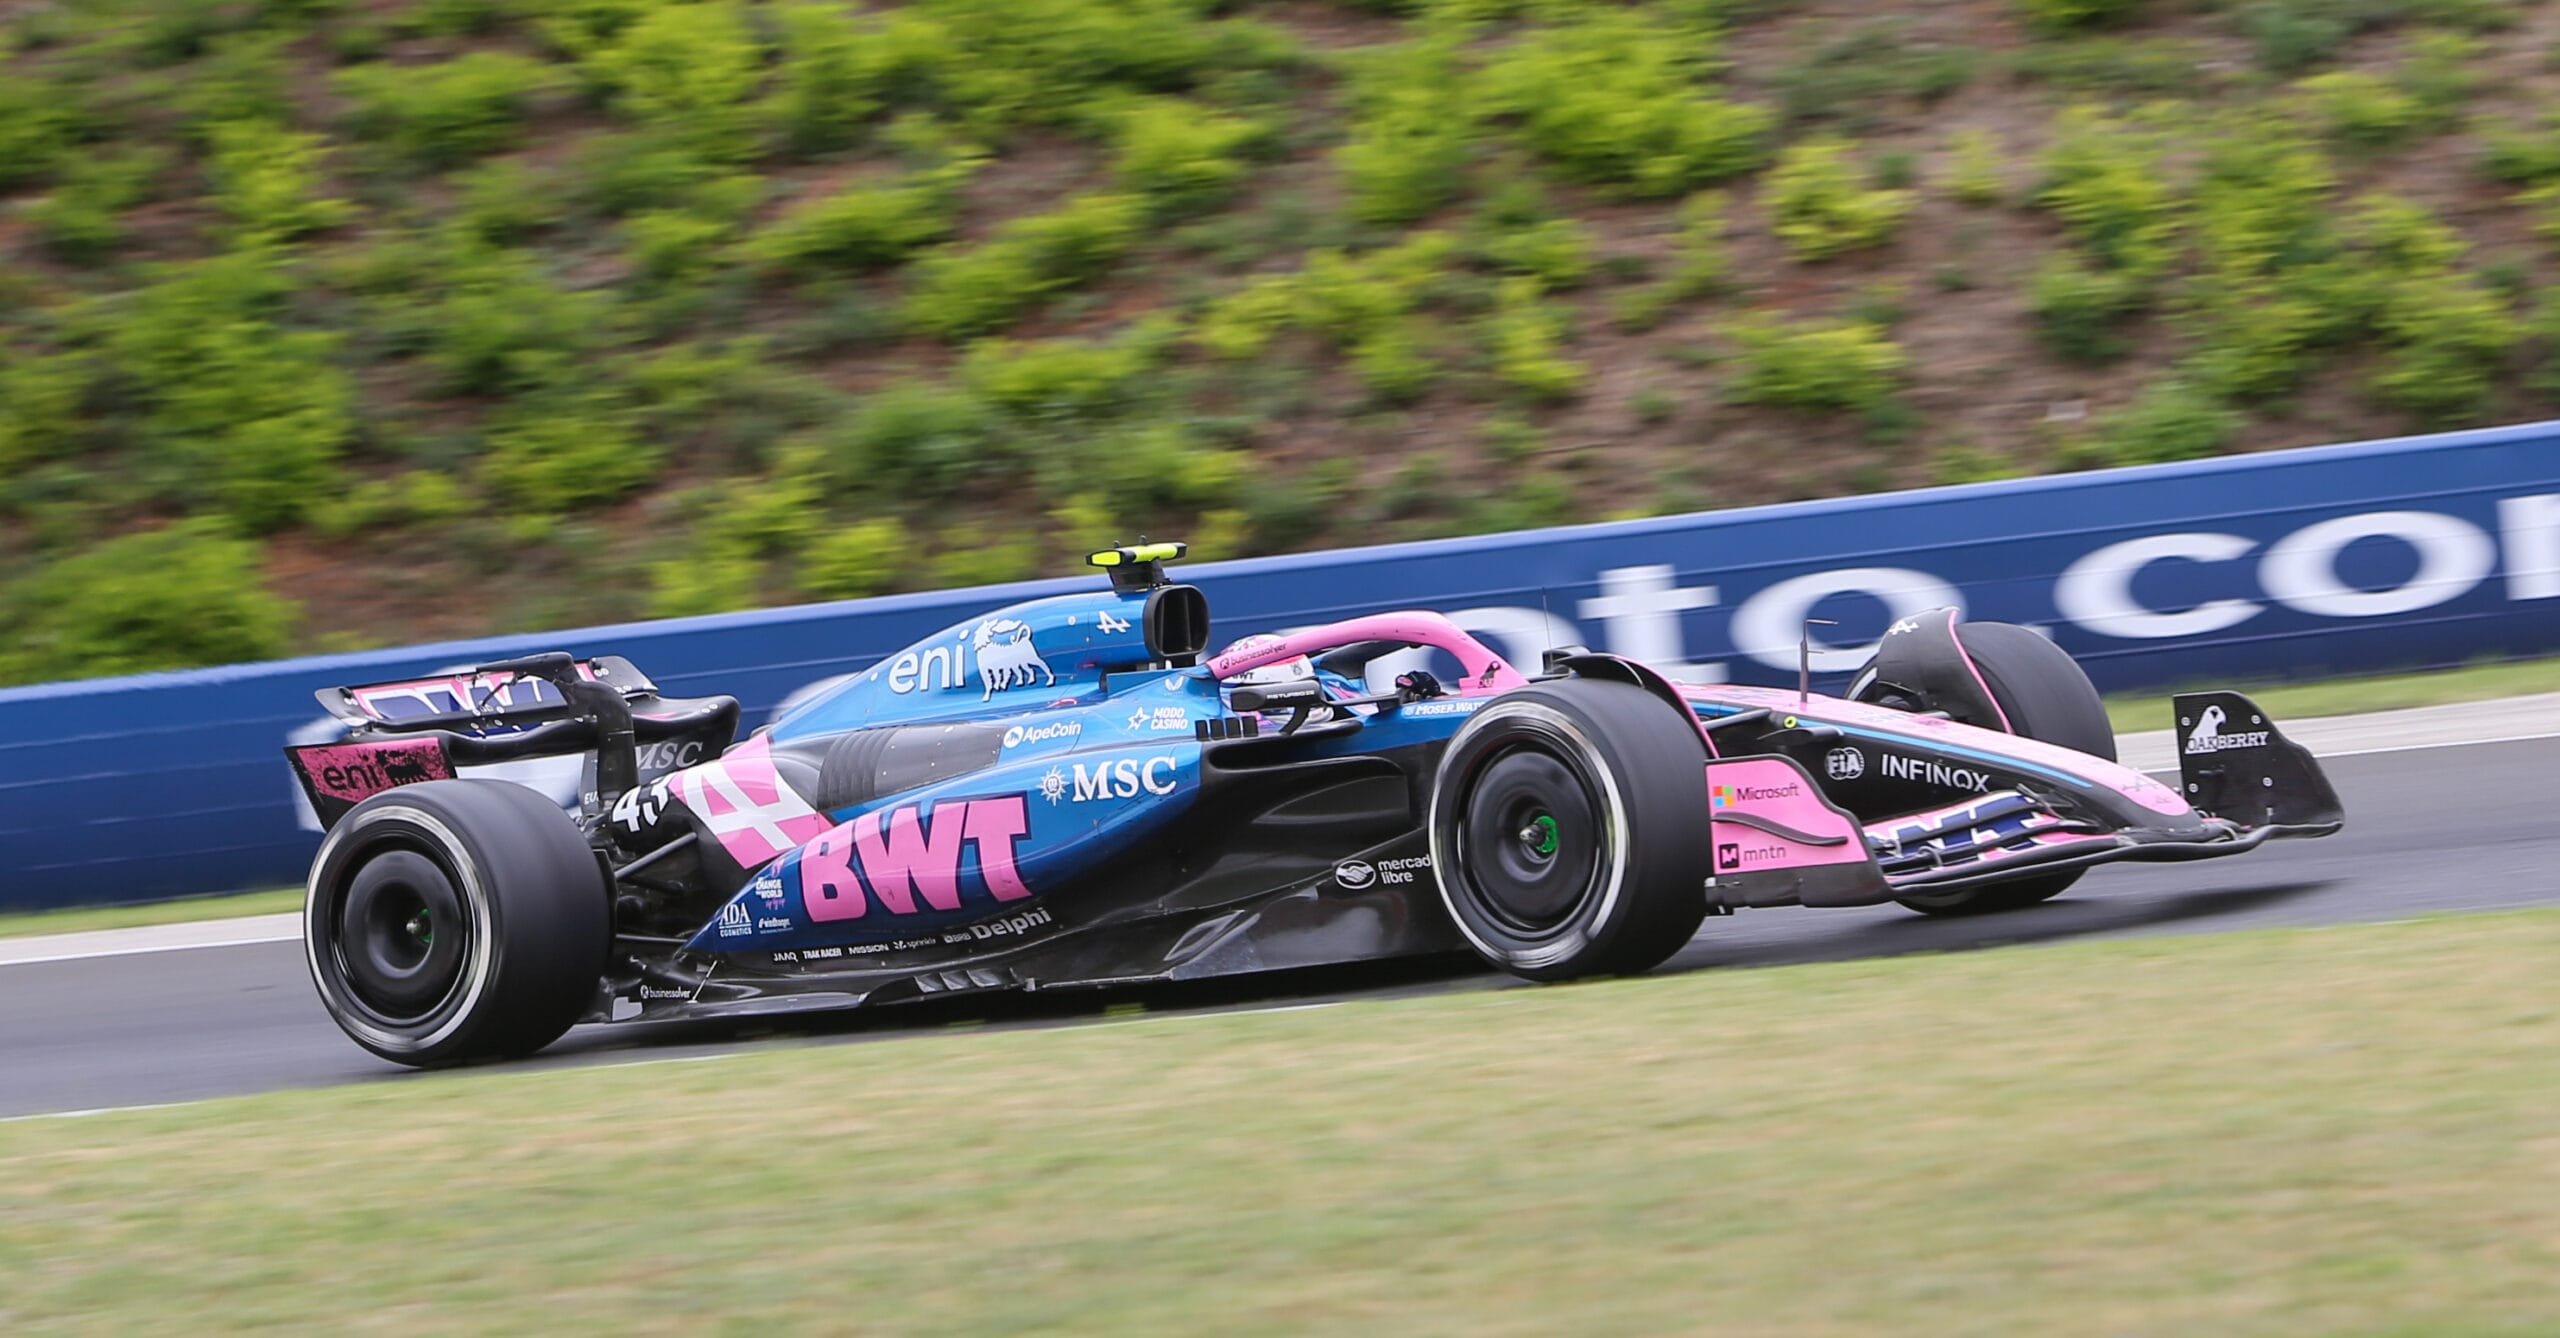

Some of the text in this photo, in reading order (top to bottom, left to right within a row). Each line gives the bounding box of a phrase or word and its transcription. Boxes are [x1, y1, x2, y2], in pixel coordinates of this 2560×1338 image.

[888, 629, 970, 694] eni
[1150, 718, 1188, 730] CASINO
[1153, 707, 1186, 718] MODO
[1023, 721, 1082, 744] ApeCoin
[2184, 731, 2269, 754] OAKBERRY
[322, 762, 382, 790] eni
[1072, 756, 1177, 802] MSC
[1881, 753, 1990, 792] INFINOX
[1737, 782, 1800, 801] Microsoft
[799, 795, 1034, 923] BWT
[1378, 853, 1433, 871] mercad
[1743, 845, 1787, 862] mntn
[1380, 871, 1414, 884] libre
[719, 902, 752, 925] ADA
[969, 907, 1052, 939] Delphi
[848, 944, 889, 955] MISSION
